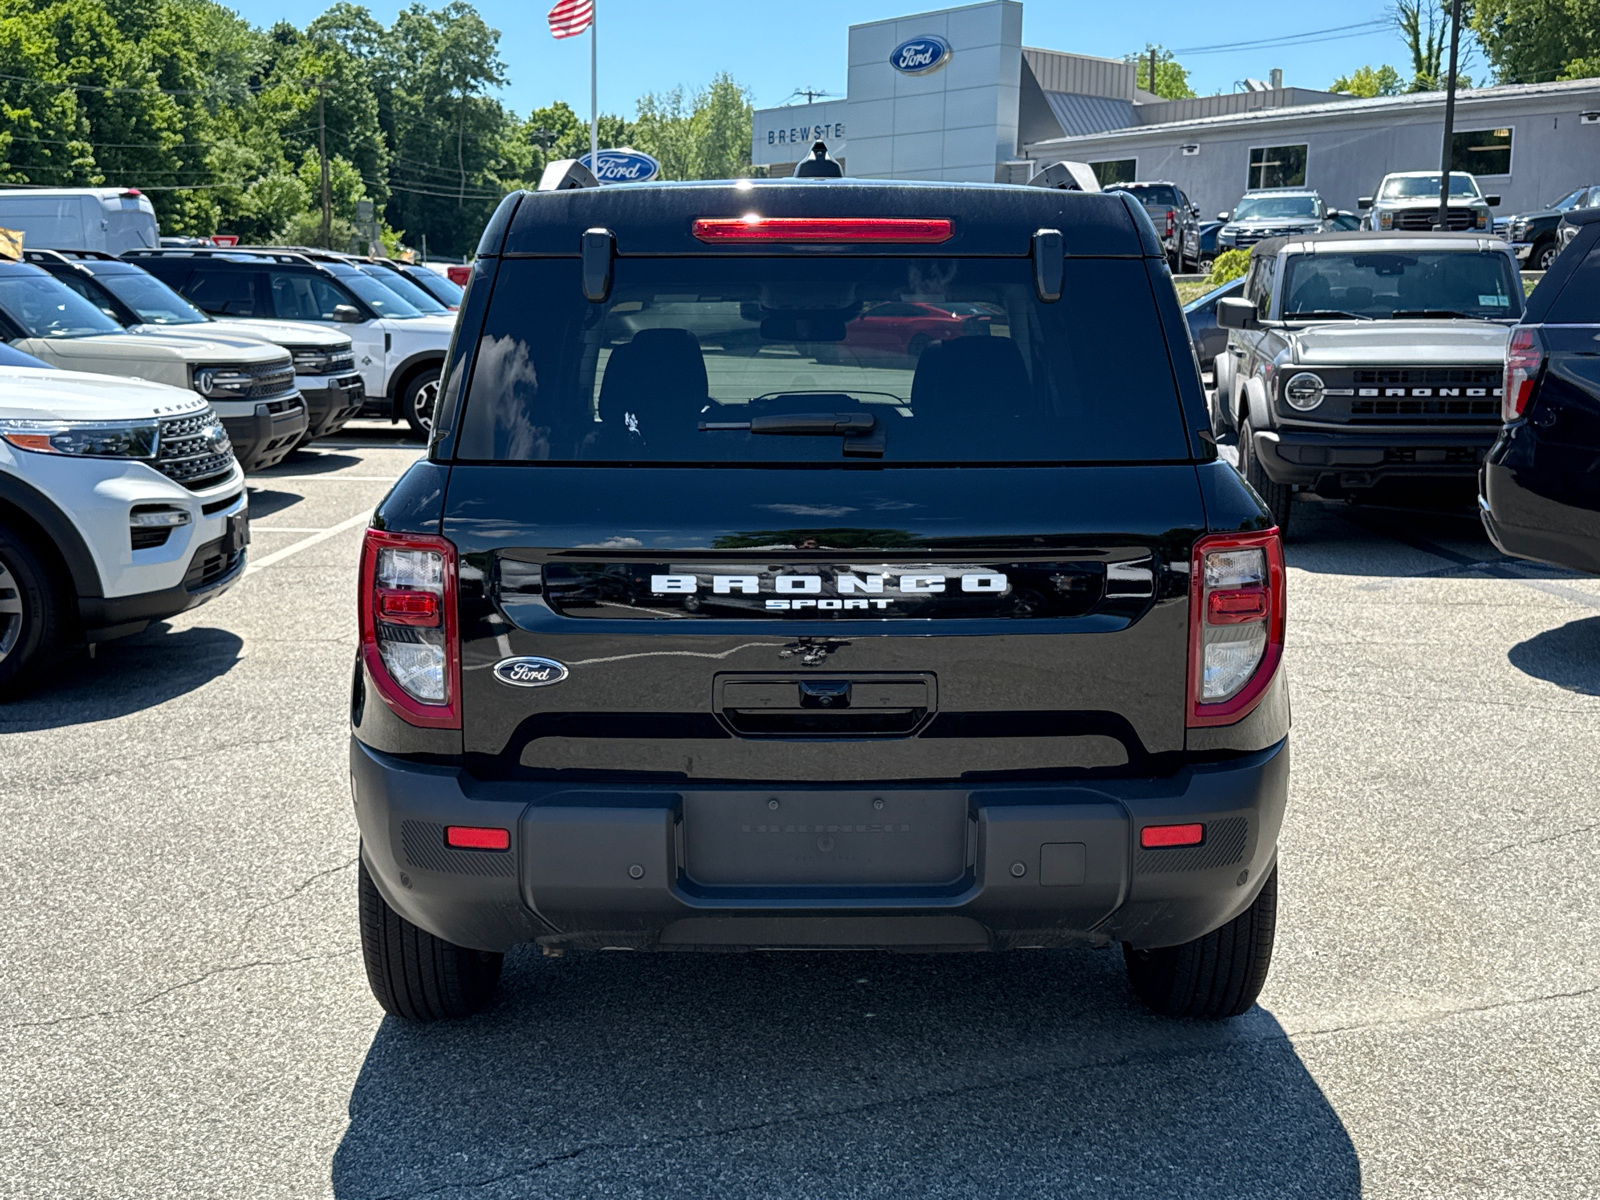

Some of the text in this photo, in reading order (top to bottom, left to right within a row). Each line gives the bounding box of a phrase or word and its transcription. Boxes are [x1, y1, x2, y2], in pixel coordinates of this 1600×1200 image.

[899, 44, 933, 68] Ford
[768, 122, 842, 145] BREWSTE
[597, 157, 641, 178] Ford
[651, 574, 1007, 593] BRONCO
[765, 599, 894, 609] SPORT
[510, 663, 550, 680] Ford
